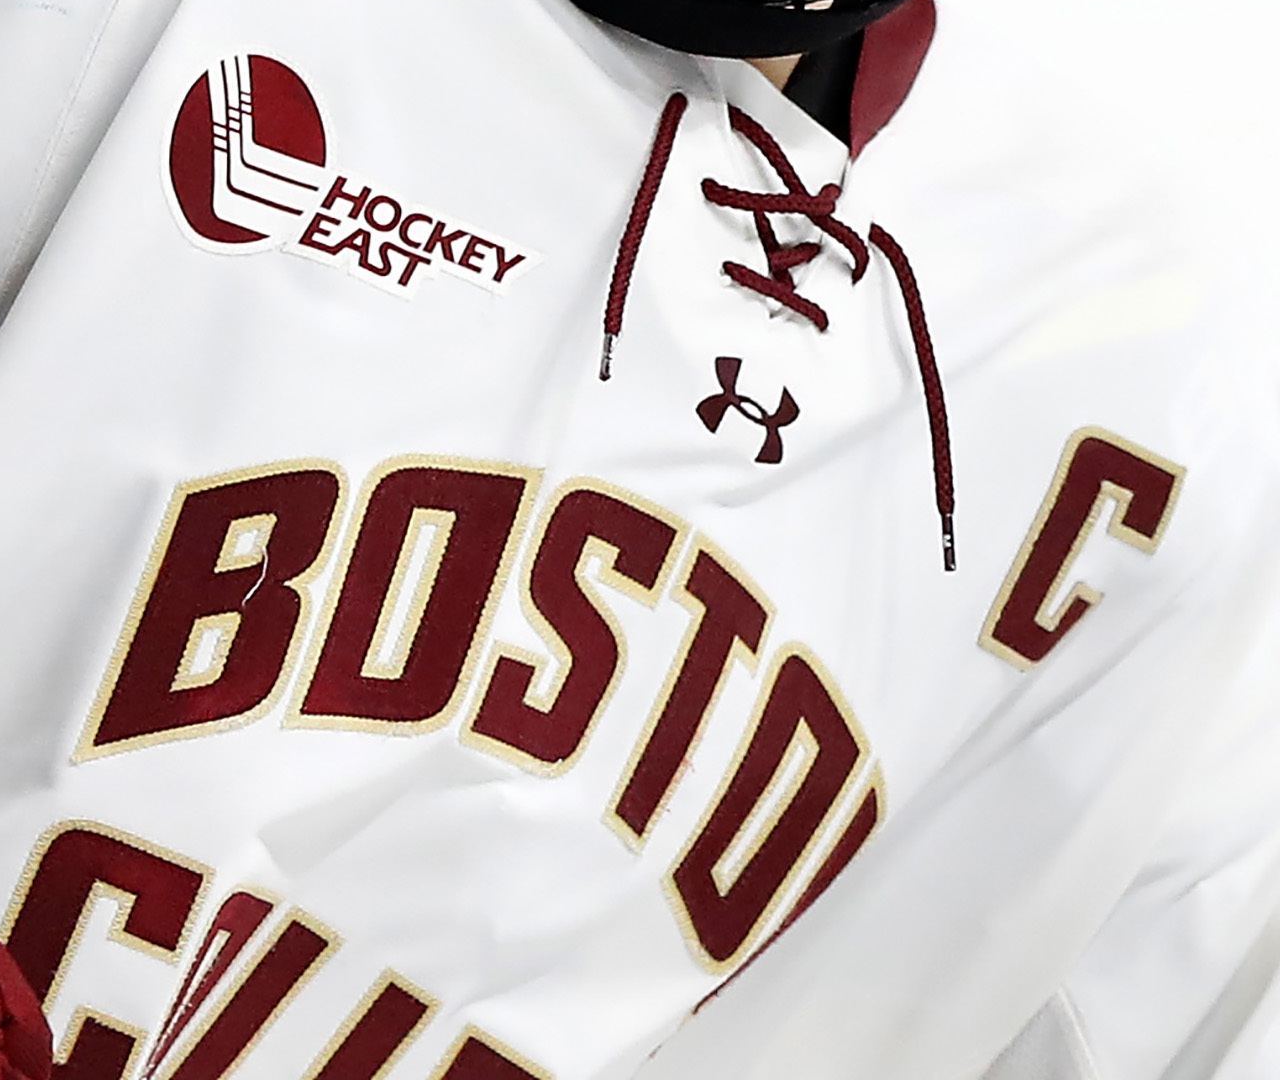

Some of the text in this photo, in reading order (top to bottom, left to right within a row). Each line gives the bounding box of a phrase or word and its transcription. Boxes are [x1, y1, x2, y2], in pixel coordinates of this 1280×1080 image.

[299, 212, 432, 287] EAST
[321, 176, 526, 283] HOCKEY
[977, 426, 1188, 672] C
[70, 452, 888, 1016] BOSTO
